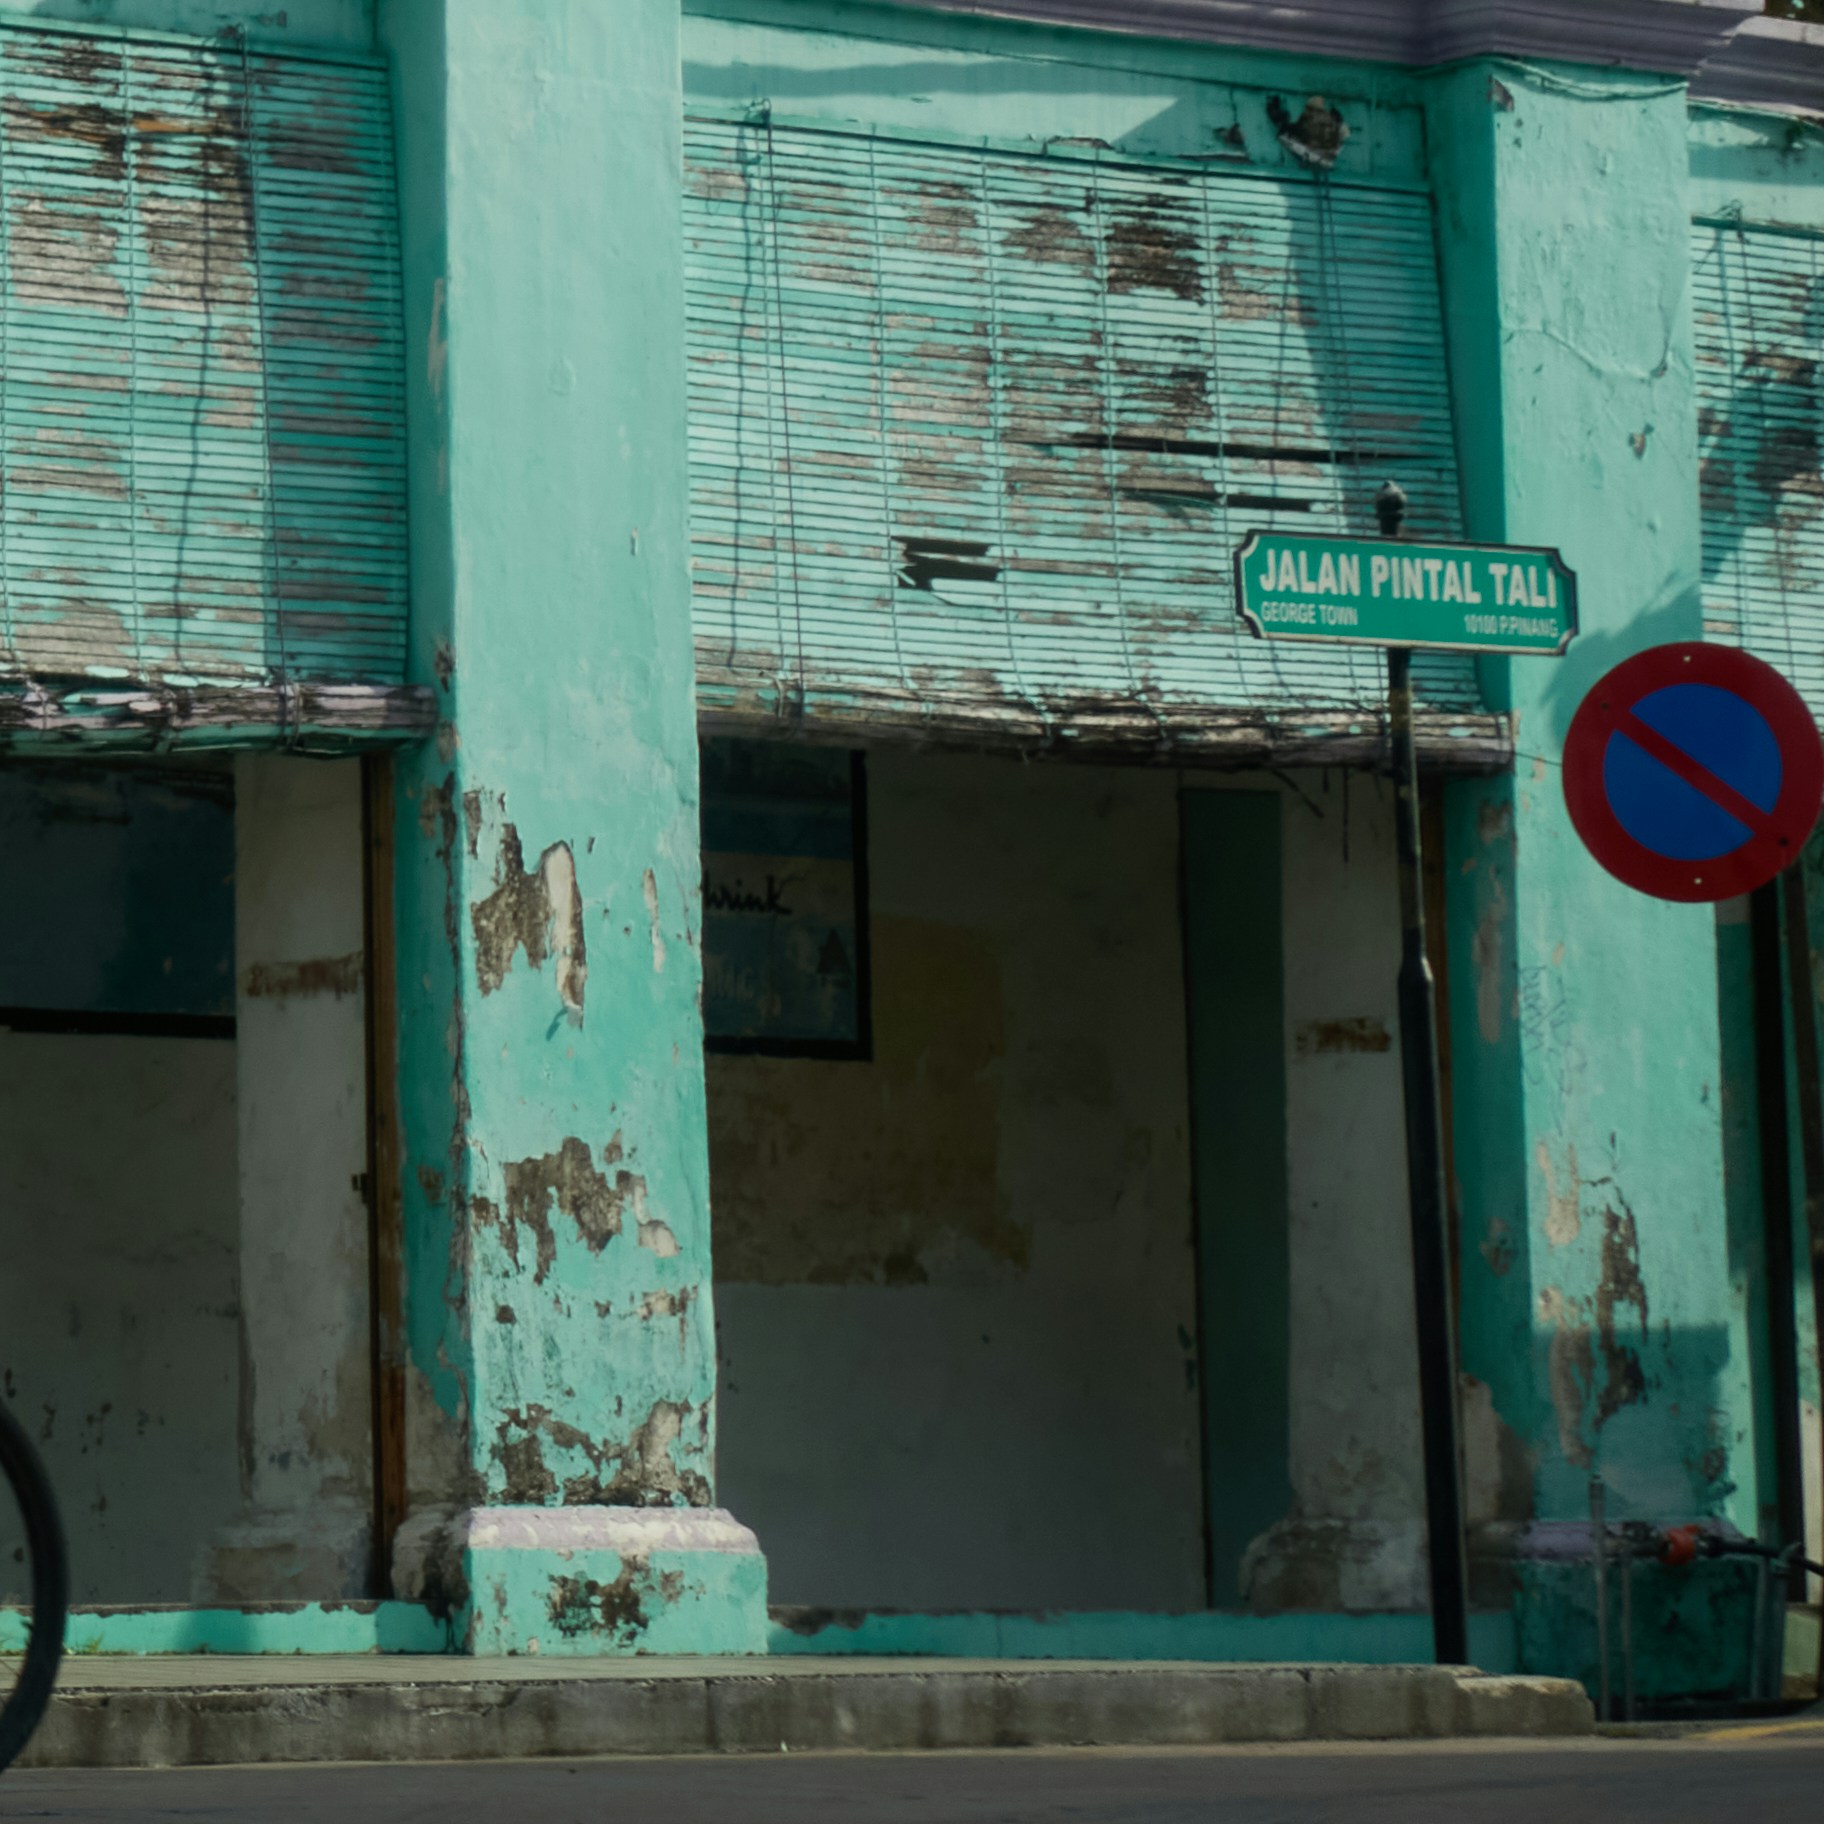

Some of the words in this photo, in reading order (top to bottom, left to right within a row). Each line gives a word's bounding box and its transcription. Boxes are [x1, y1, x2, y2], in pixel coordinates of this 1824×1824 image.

[1259, 549, 1360, 597] JALAN
[1370, 555, 1482, 604] PINTAL
[1489, 562, 1558, 608] TALI
[1261, 601, 1316, 625] GEORGE
[1319, 604, 1358, 626] TOWN
